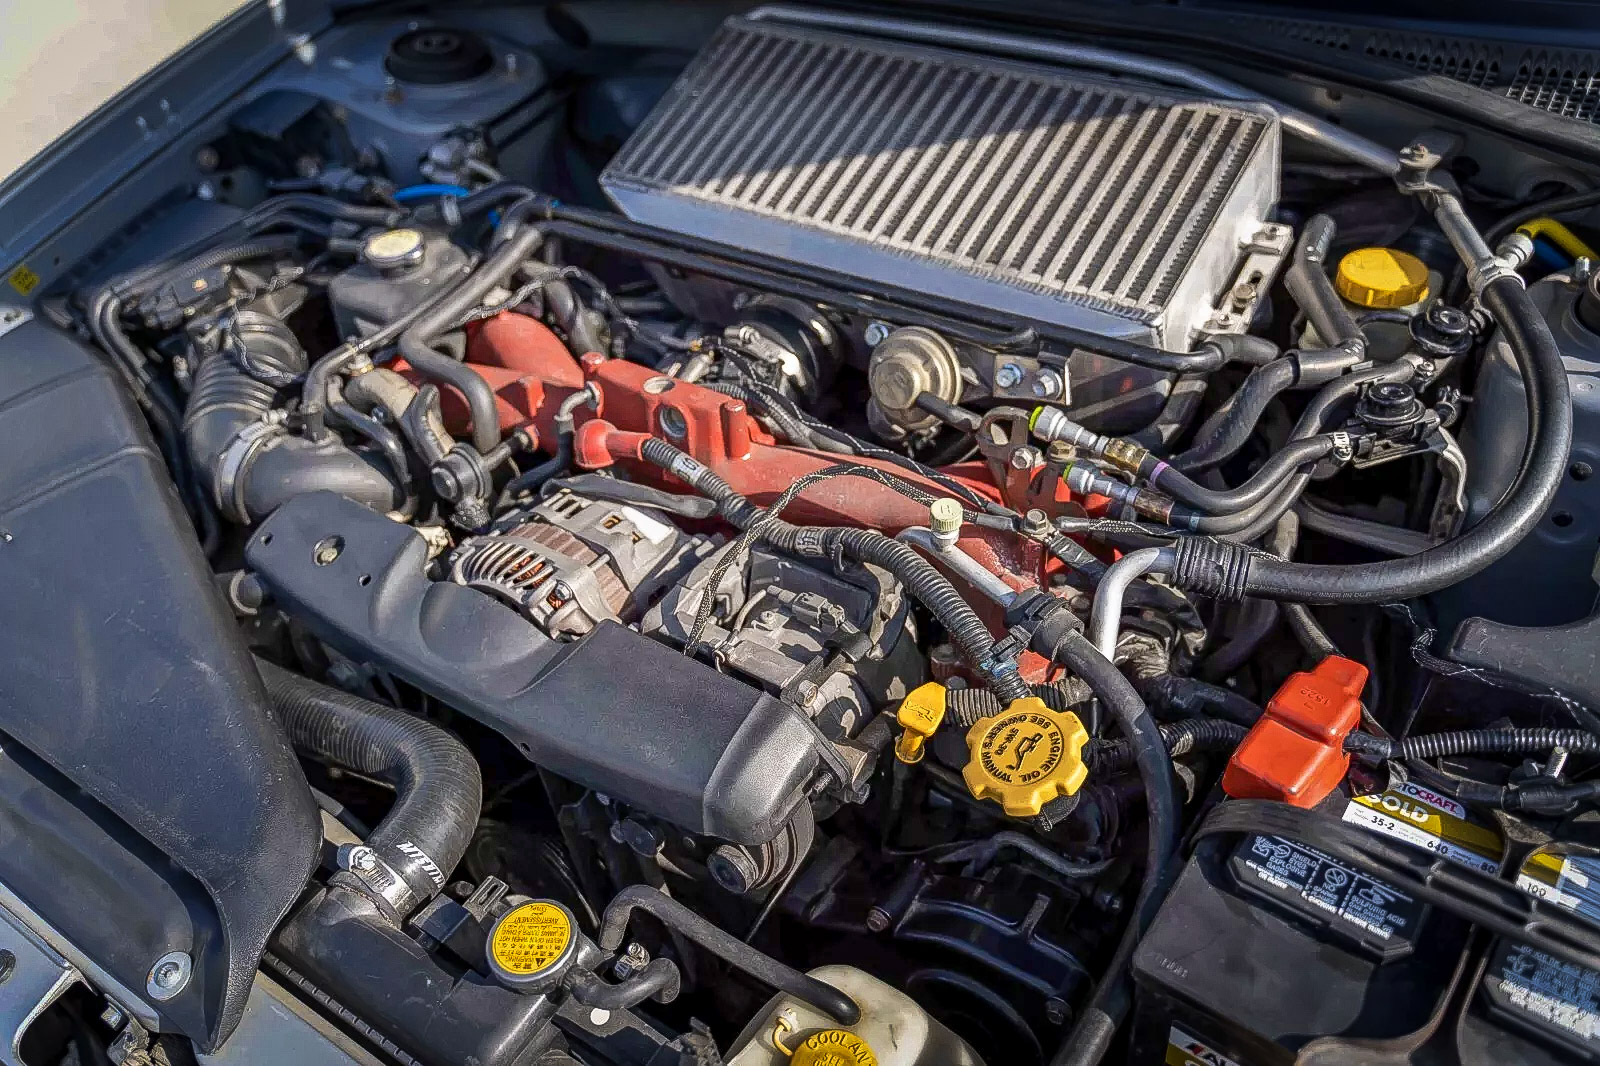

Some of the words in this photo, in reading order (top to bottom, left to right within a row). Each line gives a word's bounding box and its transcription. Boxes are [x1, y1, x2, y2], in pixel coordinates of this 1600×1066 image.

[1030, 715, 1052, 730] SEE
[1040, 731, 1061, 772] ENGINE
[981, 752, 1013, 783] MANUAL
[1019, 770, 1041, 782] OIL
[1397, 783, 1457, 812] TOCRAFT
[1371, 815, 1395, 831] 35-2
[1427, 840, 1448, 855] 640
[1322, 882, 1337, 892] NO
[806, 1031, 873, 1066] COOLAN
